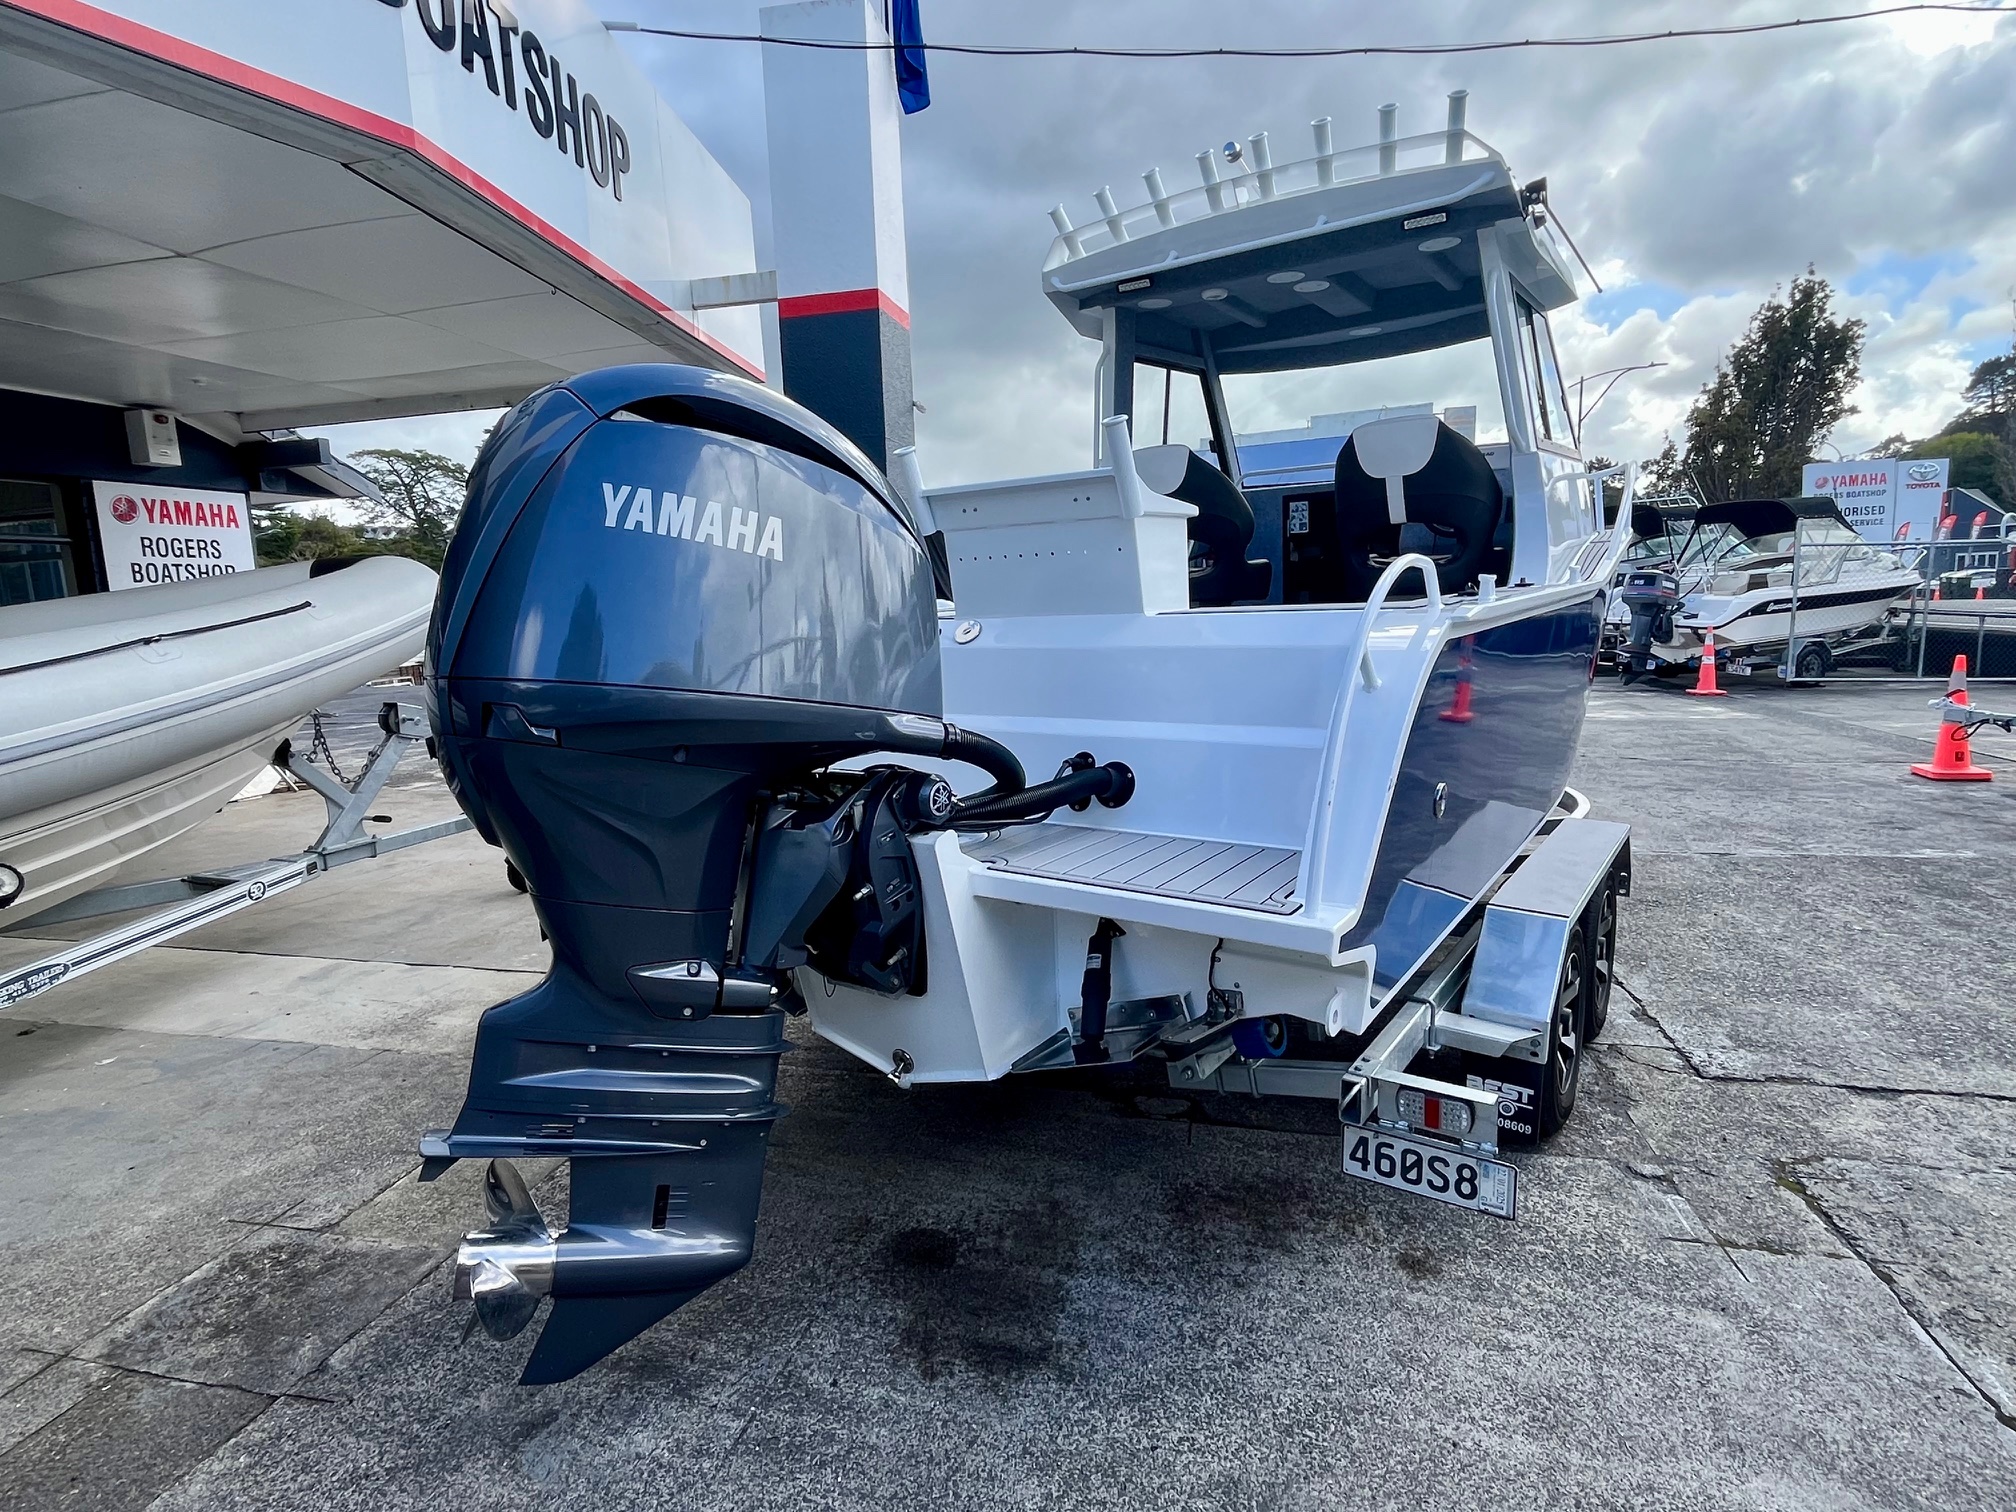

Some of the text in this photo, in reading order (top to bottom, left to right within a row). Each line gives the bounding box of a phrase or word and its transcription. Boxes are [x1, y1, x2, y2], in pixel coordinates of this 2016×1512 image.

[1831, 472, 1887, 489] YAMAHA
[1905, 482, 1941, 490] TOYOTA
[1846, 489, 1887, 499] BOATSHOP
[140, 497, 240, 529] YAMAHA
[602, 482, 783, 562] YAMAHA
[1850, 518, 1885, 527] SERVICE
[140, 536, 222, 560] ROGERS
[1466, 1074, 1534, 1104] BEST
[1497, 1117, 1532, 1134] 08609
[1349, 1135, 1478, 1200] 460S8
